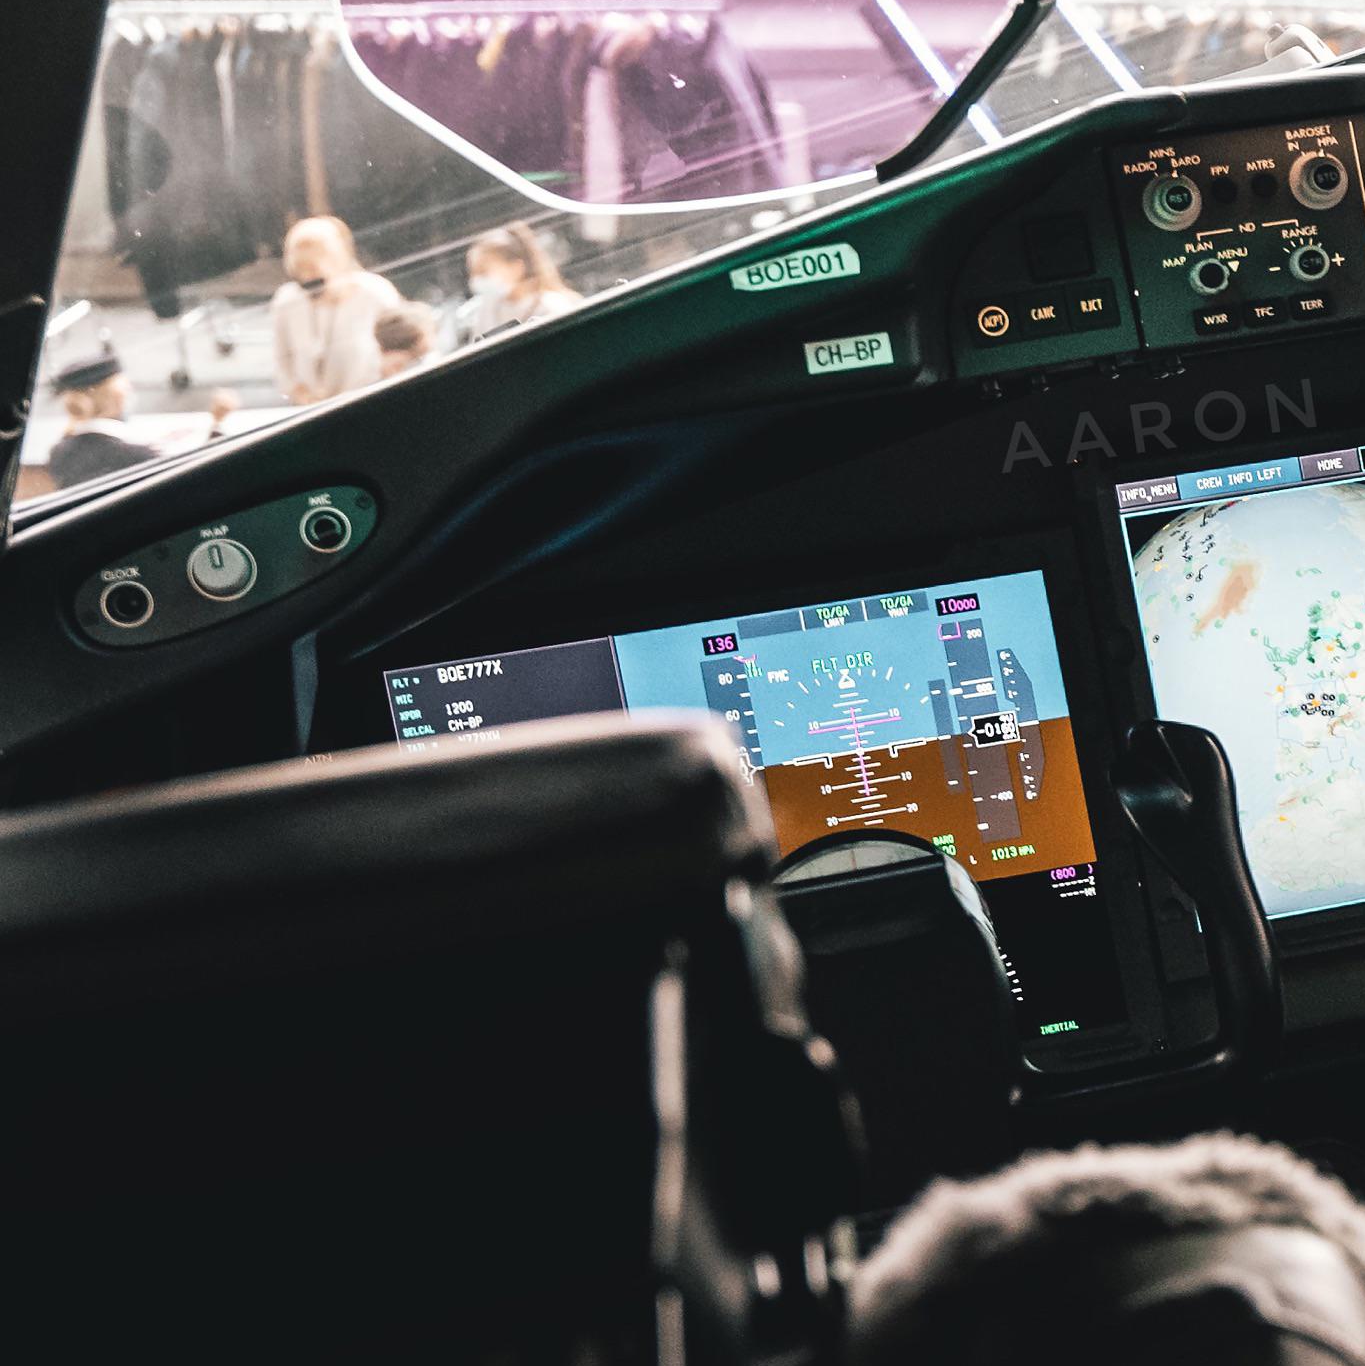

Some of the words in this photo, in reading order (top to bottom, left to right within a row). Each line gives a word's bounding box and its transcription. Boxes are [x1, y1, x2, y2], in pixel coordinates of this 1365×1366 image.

[1285, 125, 1331, 141] BAROSET
[1149, 147, 1176, 159] MINS
[1123, 161, 1158, 174] RADIO
[1171, 155, 1201, 168] BARO
[1246, 159, 1275, 172] MTRS
[1281, 225, 1318, 238] RANGE
[1184, 241, 1214, 253] PLAN
[1217, 247, 1248, 259] MENU
[747, 251, 845, 285] BOE001
[1300, 299, 1324, 311] TERR
[1254, 306, 1274, 318] TFC
[1203, 313, 1229, 326] WXR
[815, 338, 881, 366] CH-BP
[1317, 457, 1343, 471] HOME
[1196, 476, 1222, 489] CREW
[1228, 472, 1254, 485] INFO
[1257, 467, 1283, 480] LEFT
[940, 596, 977, 614] 10000
[707, 636, 735, 653] 136
[812, 656, 840, 674] FLT
[846, 651, 873, 668] DIR
[436, 659, 504, 685] BOE777X
